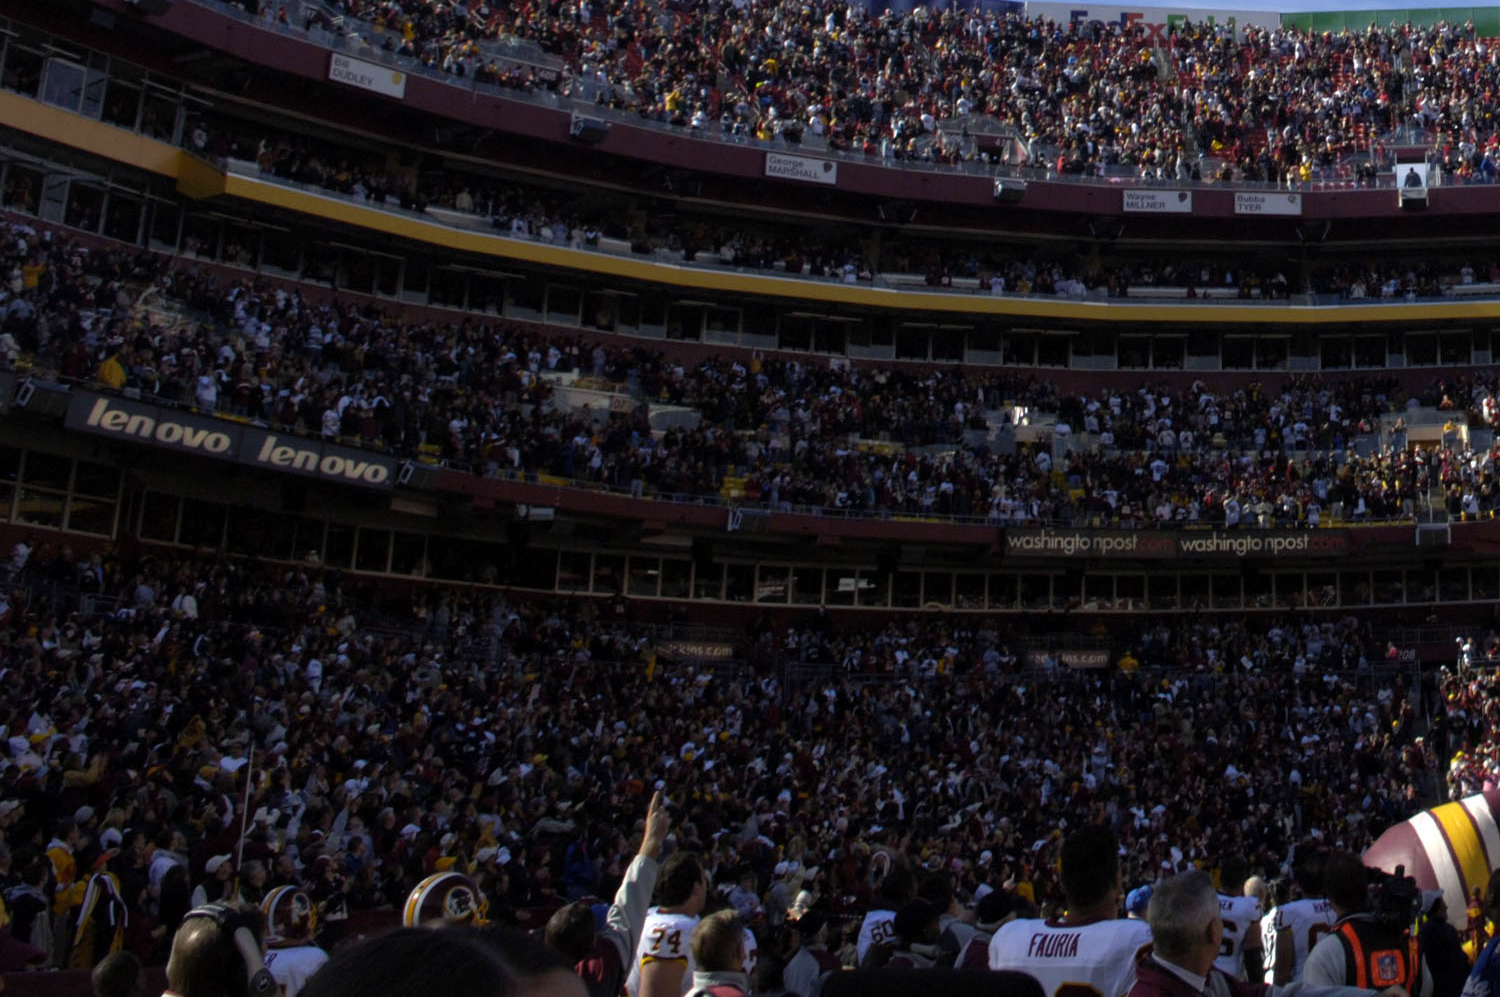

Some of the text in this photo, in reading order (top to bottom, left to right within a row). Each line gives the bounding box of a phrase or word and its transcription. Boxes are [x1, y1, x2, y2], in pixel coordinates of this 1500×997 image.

[334, 57, 350, 69] Bill
[332, 67, 375, 86] DUDLEY
[769, 156, 804, 169] George
[769, 165, 821, 179] MARSHALL
[1126, 193, 1156, 203] Wayne
[1237, 195, 1266, 203] Bubba
[1126, 201, 1166, 210] MILLNER
[1238, 203, 1262, 212] TYER
[87, 399, 231, 453] lenovo
[258, 435, 389, 483] lenovo
[871, 920, 896, 944] 60
[652, 928, 682, 954] 74
[1028, 933, 1082, 958] FAURIA
